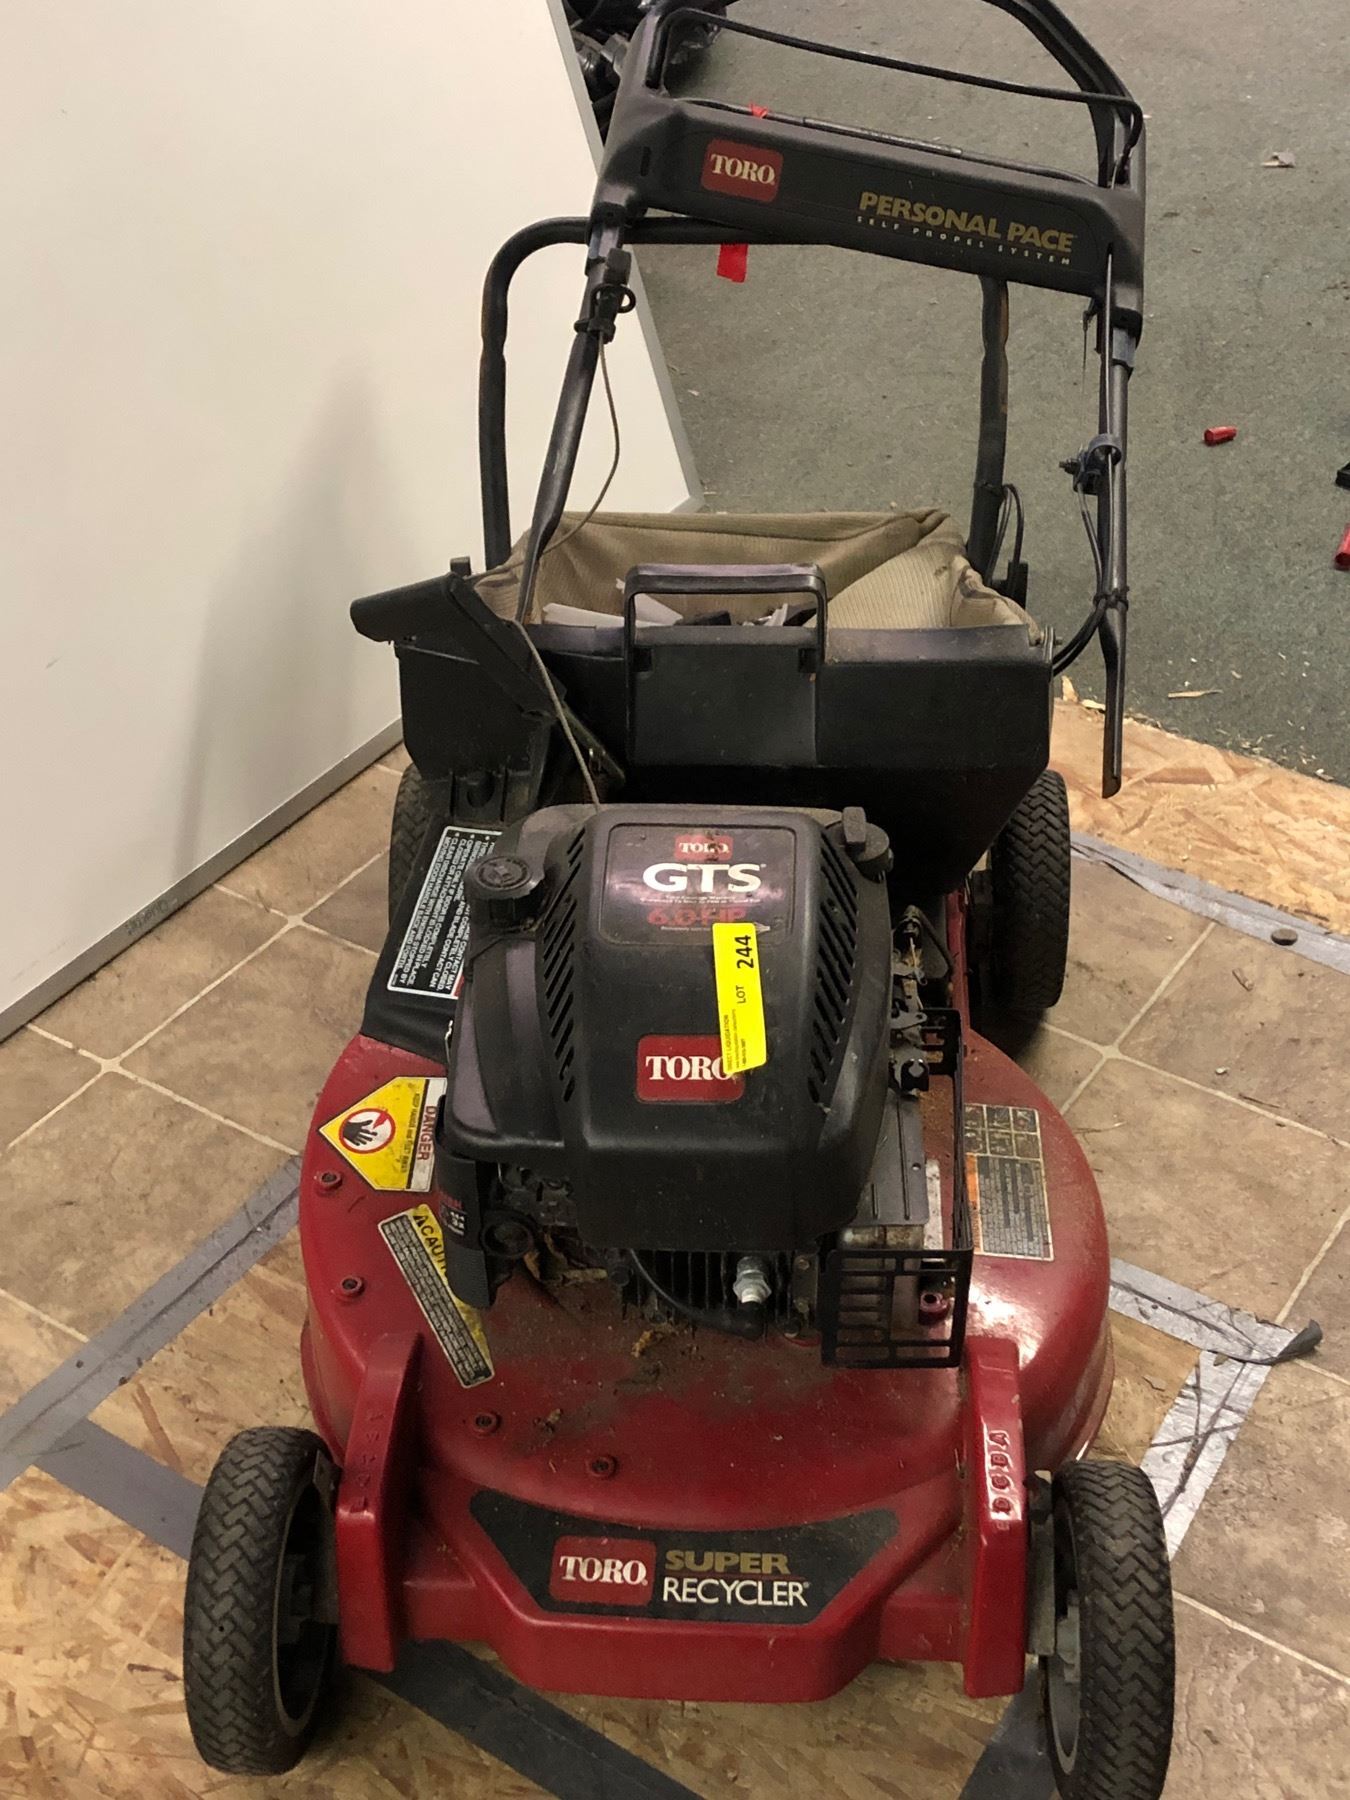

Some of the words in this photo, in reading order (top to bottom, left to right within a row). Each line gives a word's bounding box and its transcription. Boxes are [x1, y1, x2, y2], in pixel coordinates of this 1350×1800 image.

[709, 153, 774, 185] TORO
[858, 191, 1002, 240] PERSONAL
[1006, 221, 1074, 253] PACE
[856, 215, 900, 231] SELF
[912, 226, 986, 249] PROPEL
[997, 244, 1072, 266] SYSTEM
[642, 862, 762, 893] GTS
[734, 935, 755, 969] 244
[735, 985, 747, 1005] LOT
[417, 1105, 438, 1161] DANGER
[559, 1555, 648, 1586] TORO
[664, 1549, 791, 1575] SUPER
[662, 1576, 808, 1607] RECYCLER
